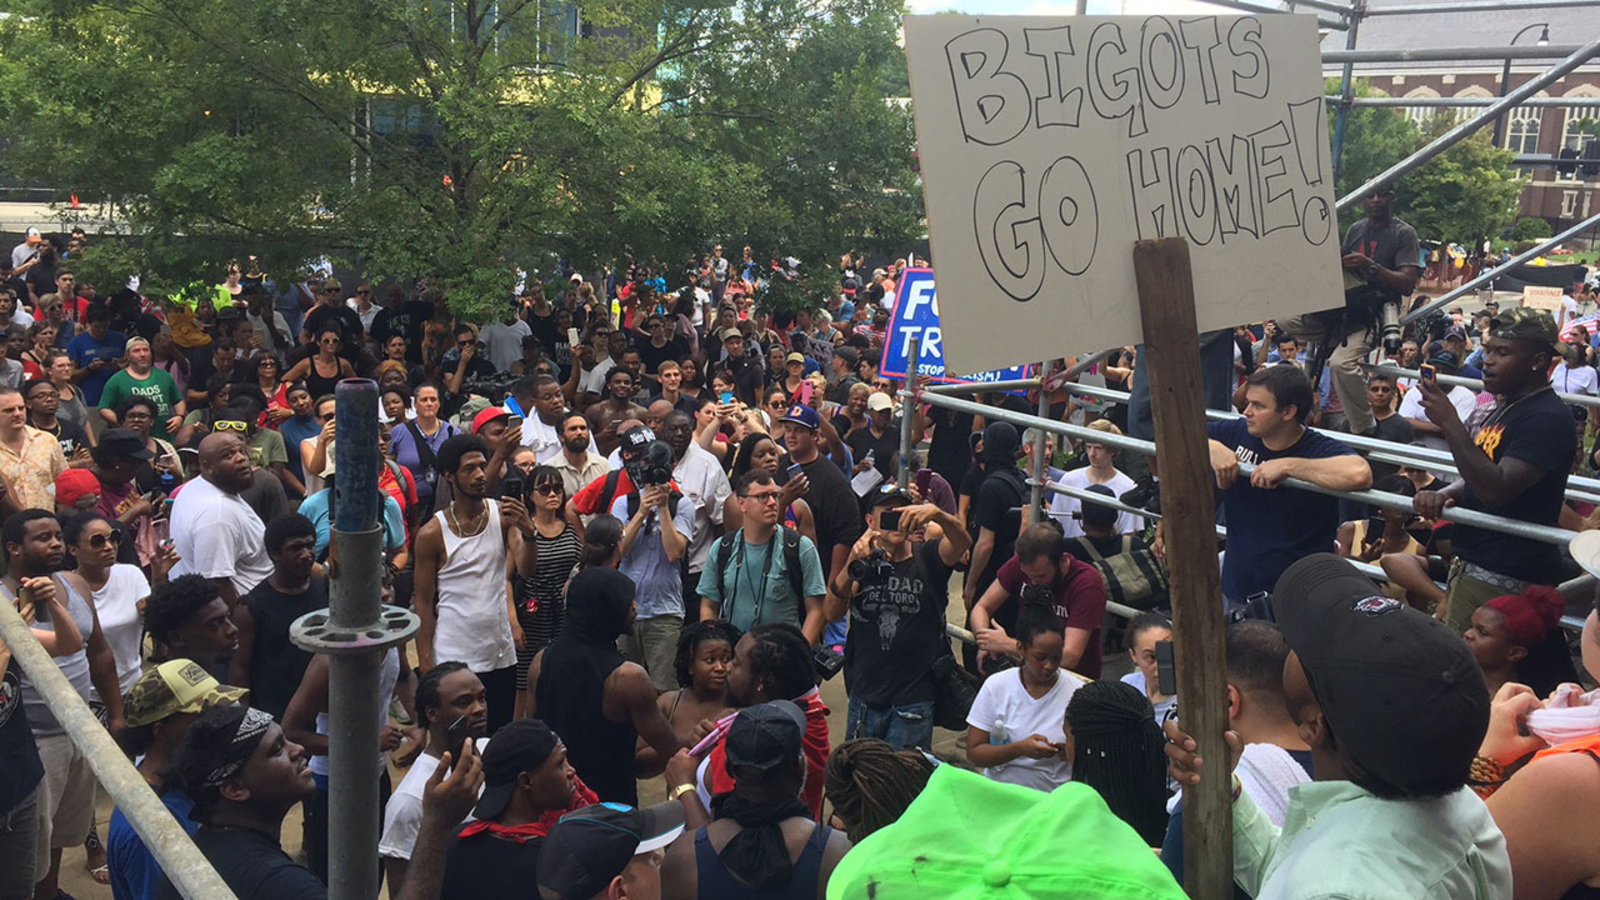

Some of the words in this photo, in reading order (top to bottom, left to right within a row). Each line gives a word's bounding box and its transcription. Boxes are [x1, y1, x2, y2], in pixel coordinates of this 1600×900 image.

[944, 15, 1270, 146] BIGOTS
[973, 155, 1099, 302] GO
[1126, 97, 1332, 247] HOME!
[899, 326, 942, 358] TR
[918, 364, 945, 375] STOP
[131, 385, 160, 396] DADS
[885, 576, 924, 594] DAD
[869, 591, 887, 602] DEL
[889, 591, 915, 604] TORO
